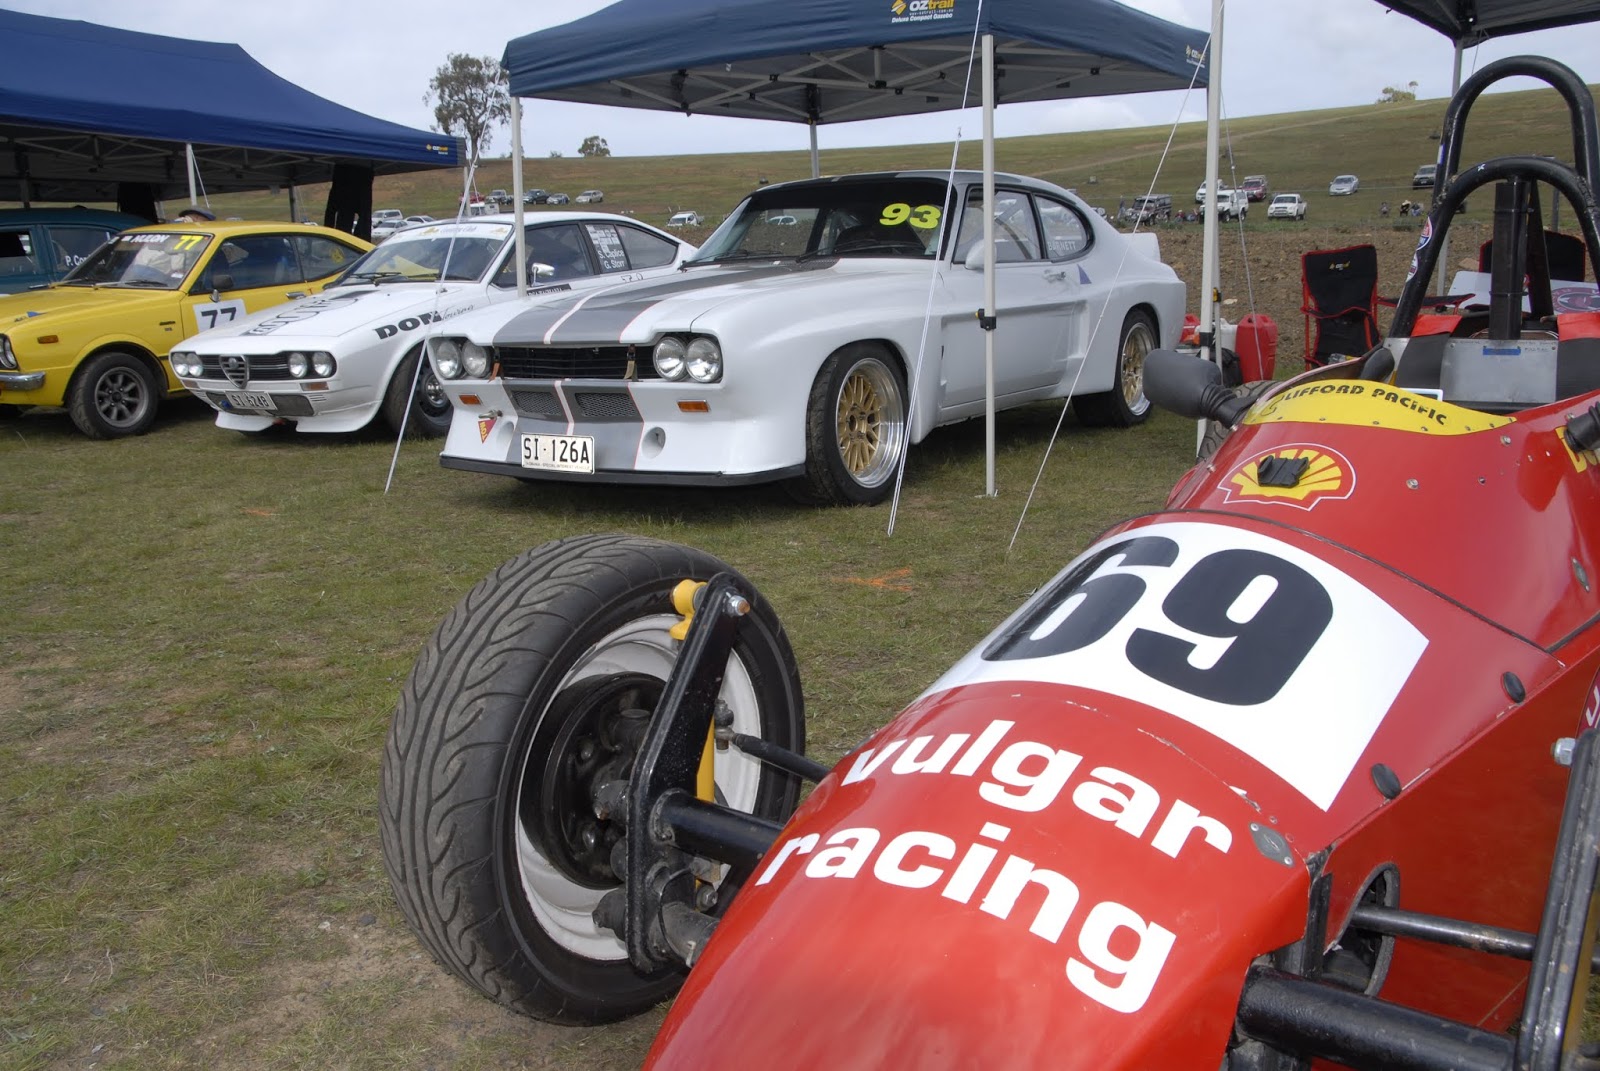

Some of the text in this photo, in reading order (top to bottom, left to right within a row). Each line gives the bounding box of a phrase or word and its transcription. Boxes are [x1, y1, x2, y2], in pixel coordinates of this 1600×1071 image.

[909, 0, 955, 11] OZtrail
[909, 14, 933, 22] Compact
[879, 203, 942, 229] 93
[173, 235, 204, 250] 77
[201, 306, 237, 329] 77
[1371, 388, 1448, 426] PACIFIC
[981, 536, 1334, 706] 69
[841, 719, 1233, 859] vulgar
[755, 822, 1177, 1014] racing
